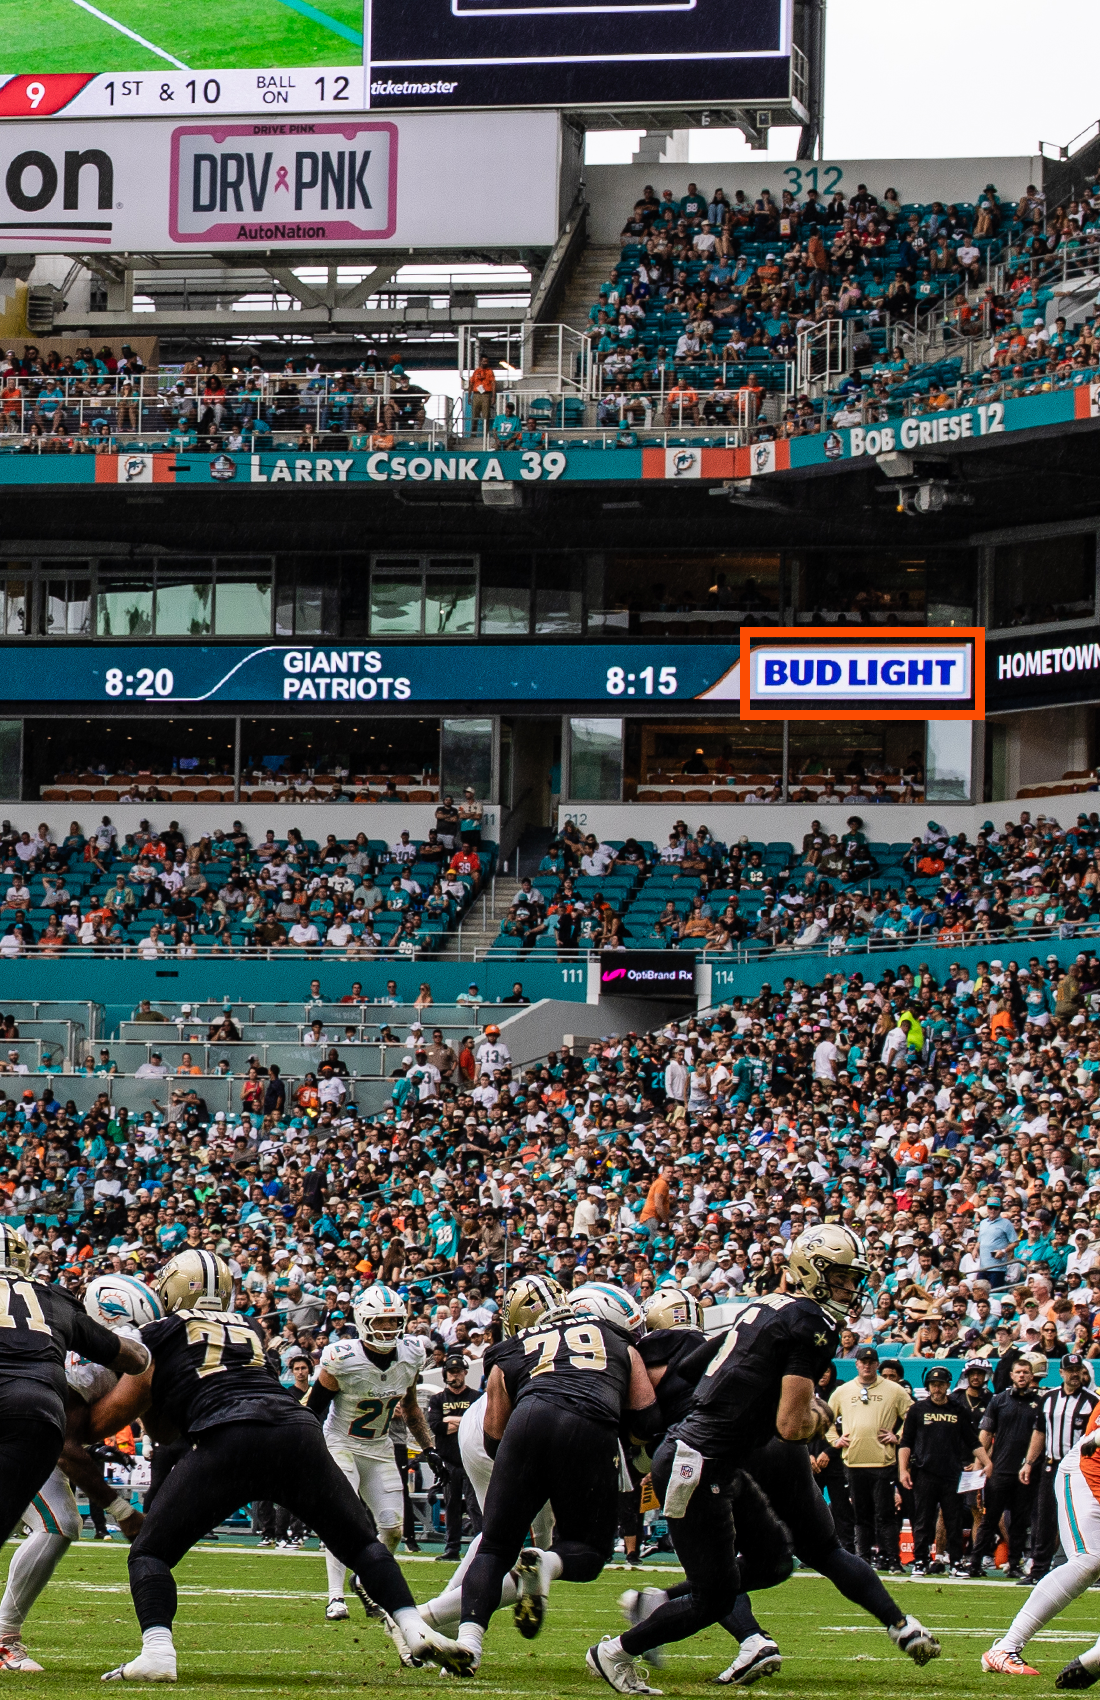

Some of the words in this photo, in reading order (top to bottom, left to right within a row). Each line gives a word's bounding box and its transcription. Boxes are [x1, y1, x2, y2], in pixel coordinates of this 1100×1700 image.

[104, 80, 144, 106] 1ST
[159, 82, 175, 102] &
[185, 78, 221, 104] 10
[256, 75, 296, 89] BALL
[314, 75, 350, 101] 12
[370, 79, 458, 96] ticketmaster
[25, 82, 46, 109] 9
[262, 90, 289, 104] ON
[253, 125, 286, 135] DRIVE
[289, 124, 316, 134] PINK
[192, 151, 274, 213] DRV
[294, 150, 373, 211] PNK
[783, 165, 843, 197] 312
[236, 224, 326, 240] AutoNation
[850, 427, 896, 458] BOB
[900, 411, 974, 450] GRIESE
[977, 402, 1005, 436] 12
[250, 454, 354, 483] LARRY
[366, 453, 504, 481] CSONKA
[519, 451, 567, 481] 39
[283, 651, 382, 673] GIANTS
[764, 659, 842, 686] BUD
[848, 659, 956, 686] LIGHT
[998, 642, 1100, 680] HOMETOWN
[105, 667, 174, 696] 8:20
[283, 677, 412, 700] PATRIOTS
[605, 666, 678, 695] 8:15
[458, 862, 471, 874] 39
[562, 969, 583, 983] 111
[627, 969, 676, 982] OptiBrand
[678, 970, 693, 981] Rx
[715, 970, 735, 985] 114
[486, 1050, 499, 1063] 13
[185, 1318, 267, 1379] 77
[522, 1323, 608, 1379] 79
[348, 1395, 403, 1439] 21
[442, 1401, 470, 1411] SAINTS
[923, 1412, 958, 1424] SAINTS
